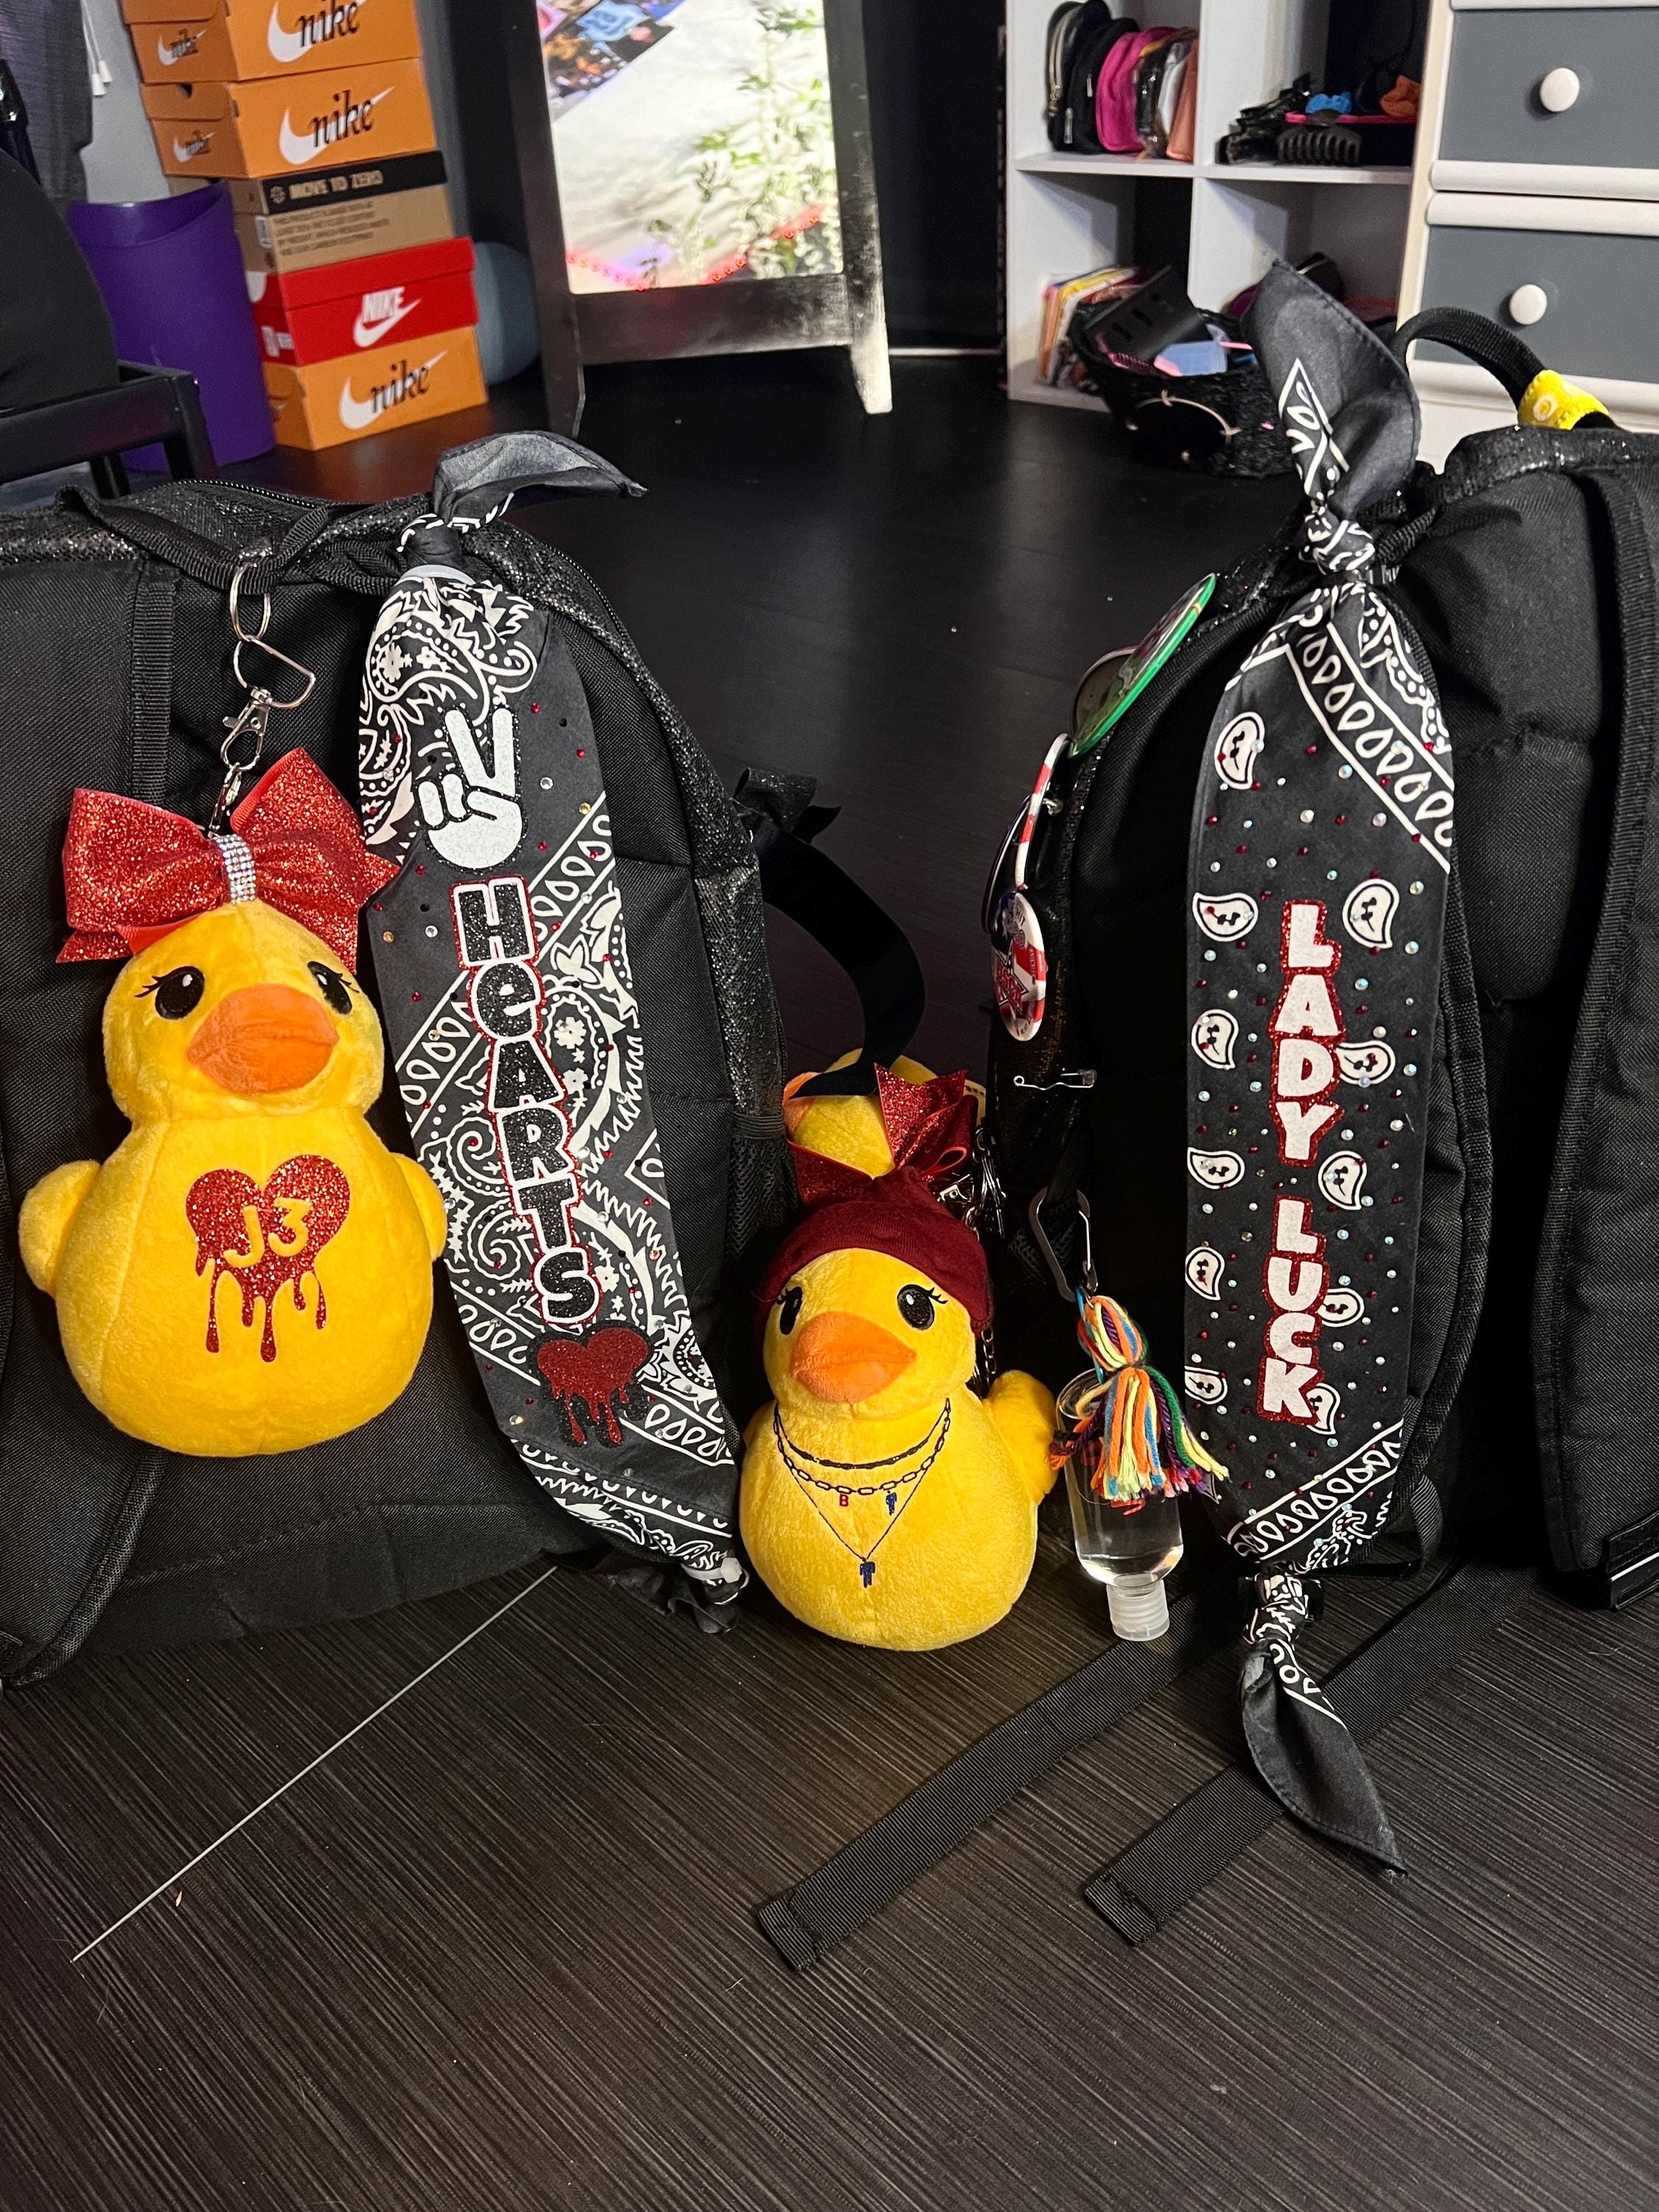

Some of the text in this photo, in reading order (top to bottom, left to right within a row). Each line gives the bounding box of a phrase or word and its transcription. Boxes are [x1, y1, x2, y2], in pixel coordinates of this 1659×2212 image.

[298, 0, 360, 47] nike
[307, 88, 375, 147] nike
[361, 285, 406, 324] NIKE
[371, 359, 431, 414] nike
[1259, 900, 1341, 1422] LADY LUCK
[223, 1197, 313, 1268] J3
[839, 1492, 849, 1507] B
